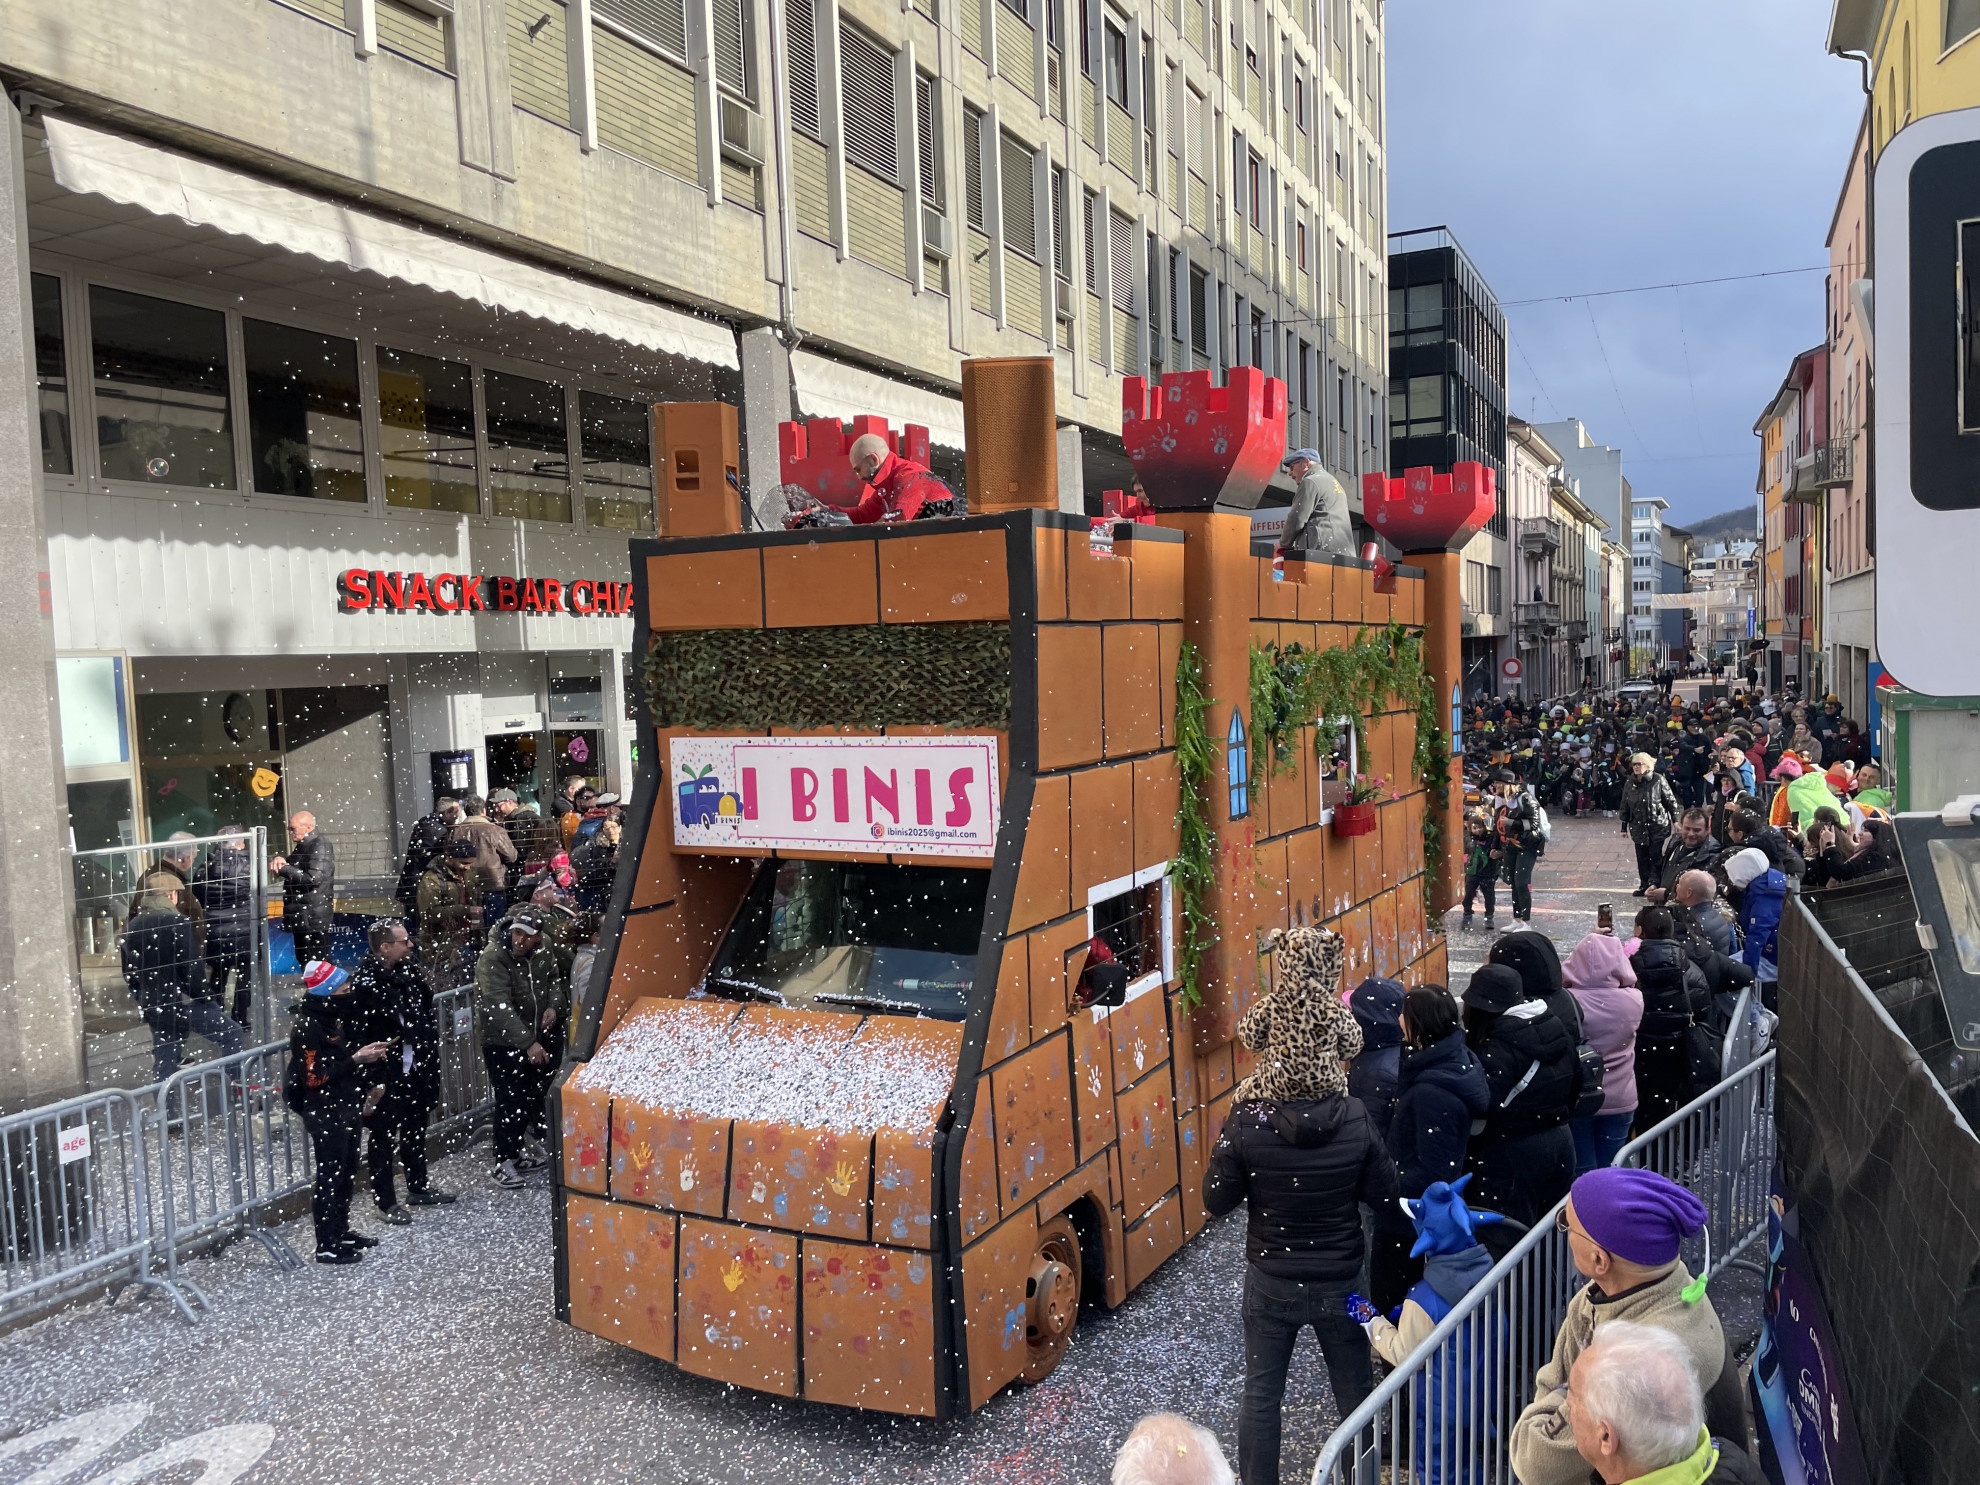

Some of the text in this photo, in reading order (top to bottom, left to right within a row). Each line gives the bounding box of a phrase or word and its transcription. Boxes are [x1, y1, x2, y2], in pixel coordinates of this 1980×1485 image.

[343, 568, 485, 612] SNACK
[498, 576, 563, 612] BAR
[742, 765, 975, 828] I BINIS
[887, 827, 977, 840] ibinis2025@gmail.com
